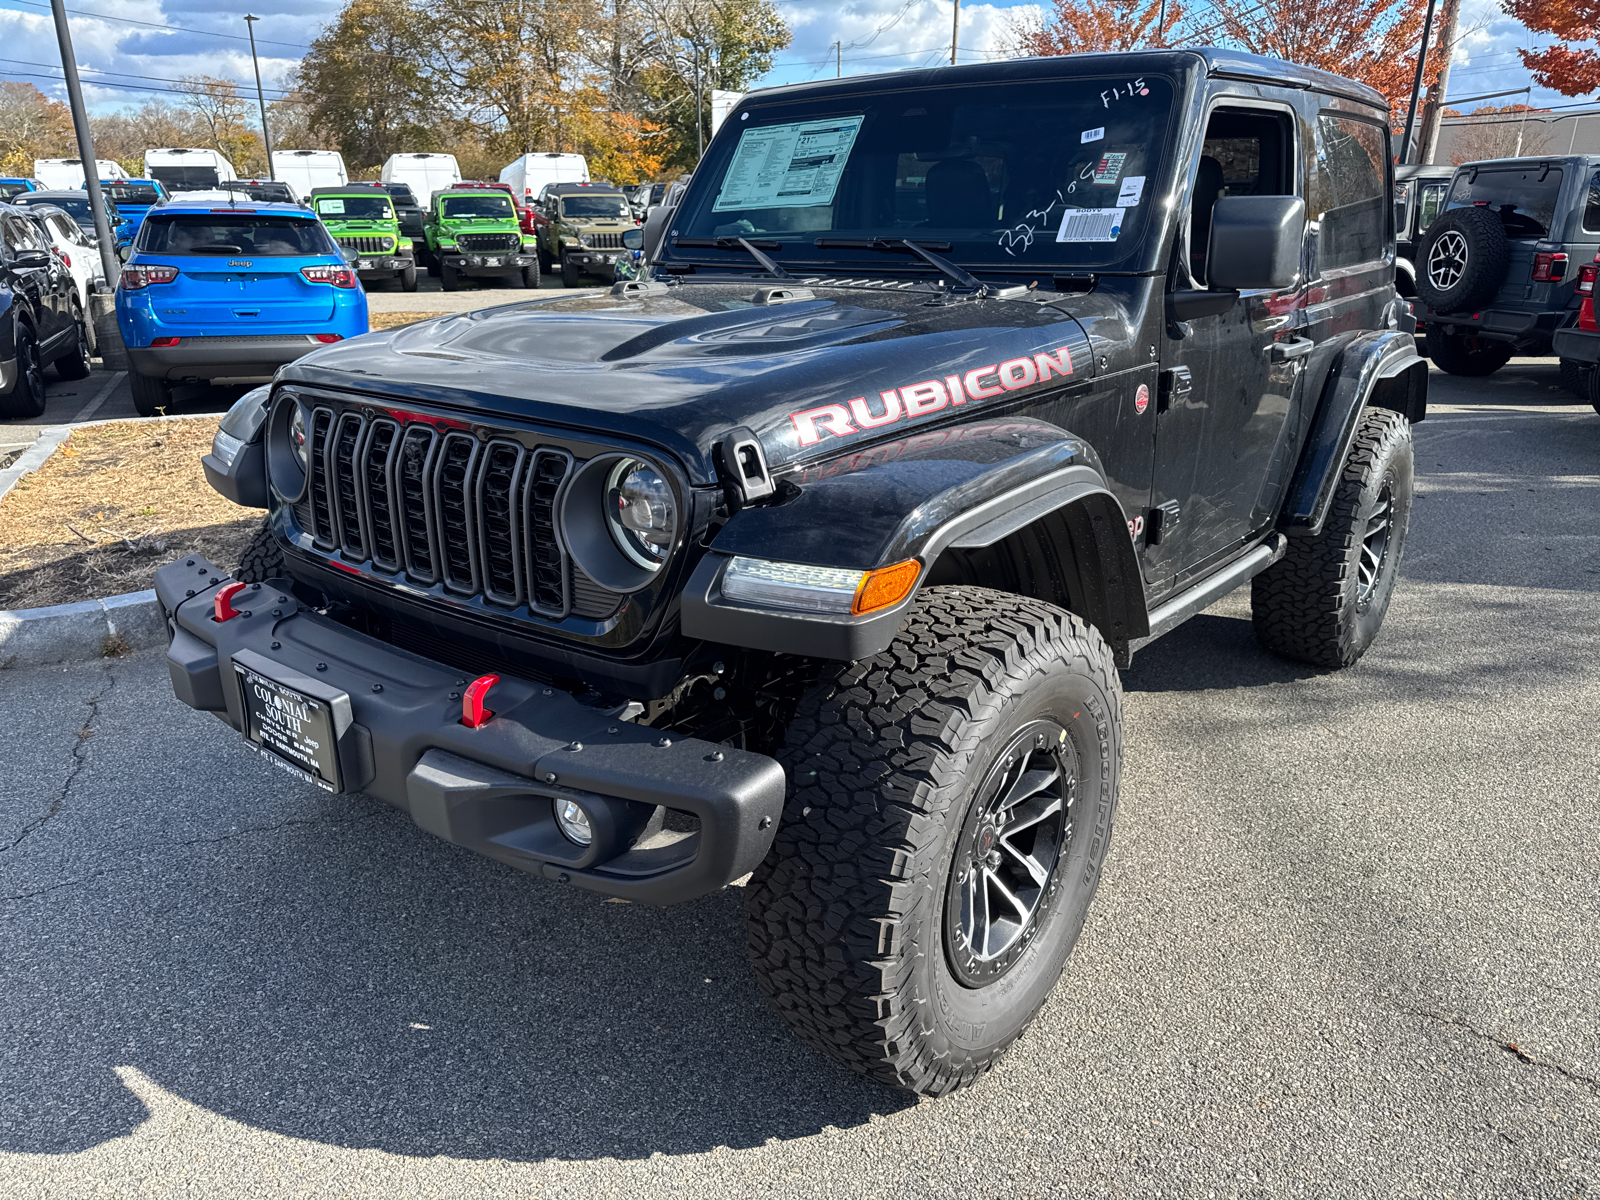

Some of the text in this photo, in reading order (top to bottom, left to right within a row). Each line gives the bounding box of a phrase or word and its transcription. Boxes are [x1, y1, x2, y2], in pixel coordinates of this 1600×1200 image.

[228, 259, 253, 268] Jeep
[790, 346, 1074, 446] RUBICON
[1128, 515, 1144, 542] ep
[256, 711, 319, 749] CHRYSLER Jeep
[265, 703, 302, 734] SOUTH
[262, 722, 313, 756] DODGE RAM
[310, 758, 320, 769] MA
